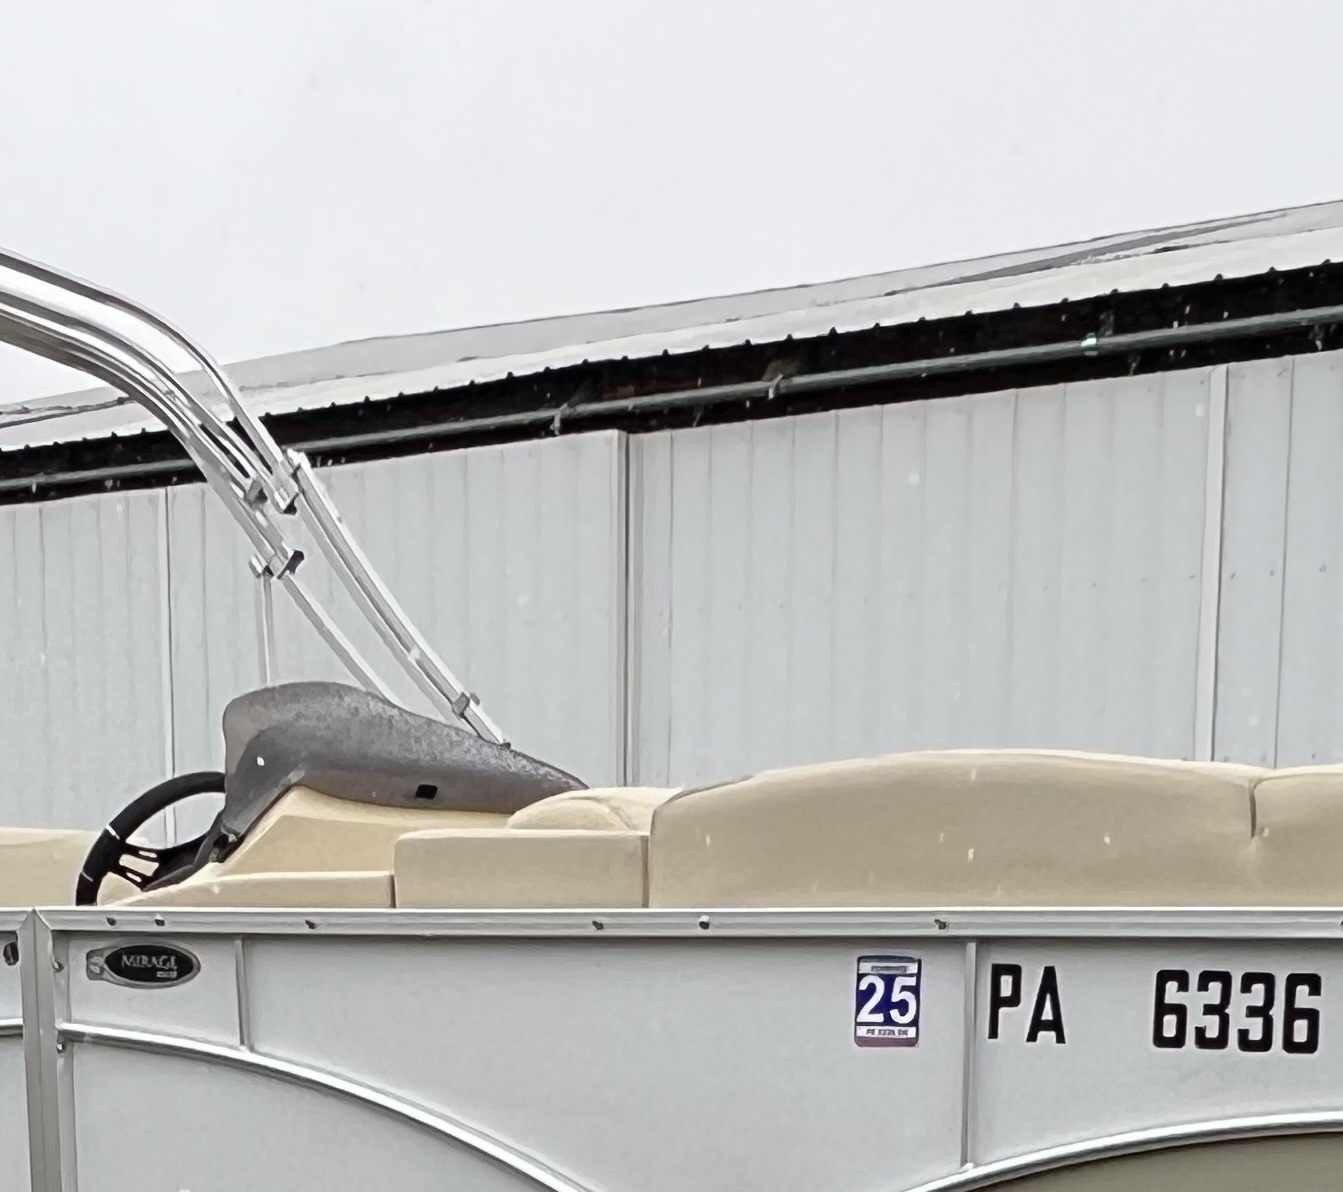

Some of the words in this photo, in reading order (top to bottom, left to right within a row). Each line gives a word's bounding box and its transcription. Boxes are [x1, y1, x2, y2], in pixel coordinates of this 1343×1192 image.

[856, 974, 917, 1024] 25
[987, 962, 1066, 1044] PA
[1152, 969, 1322, 1054] 6336
